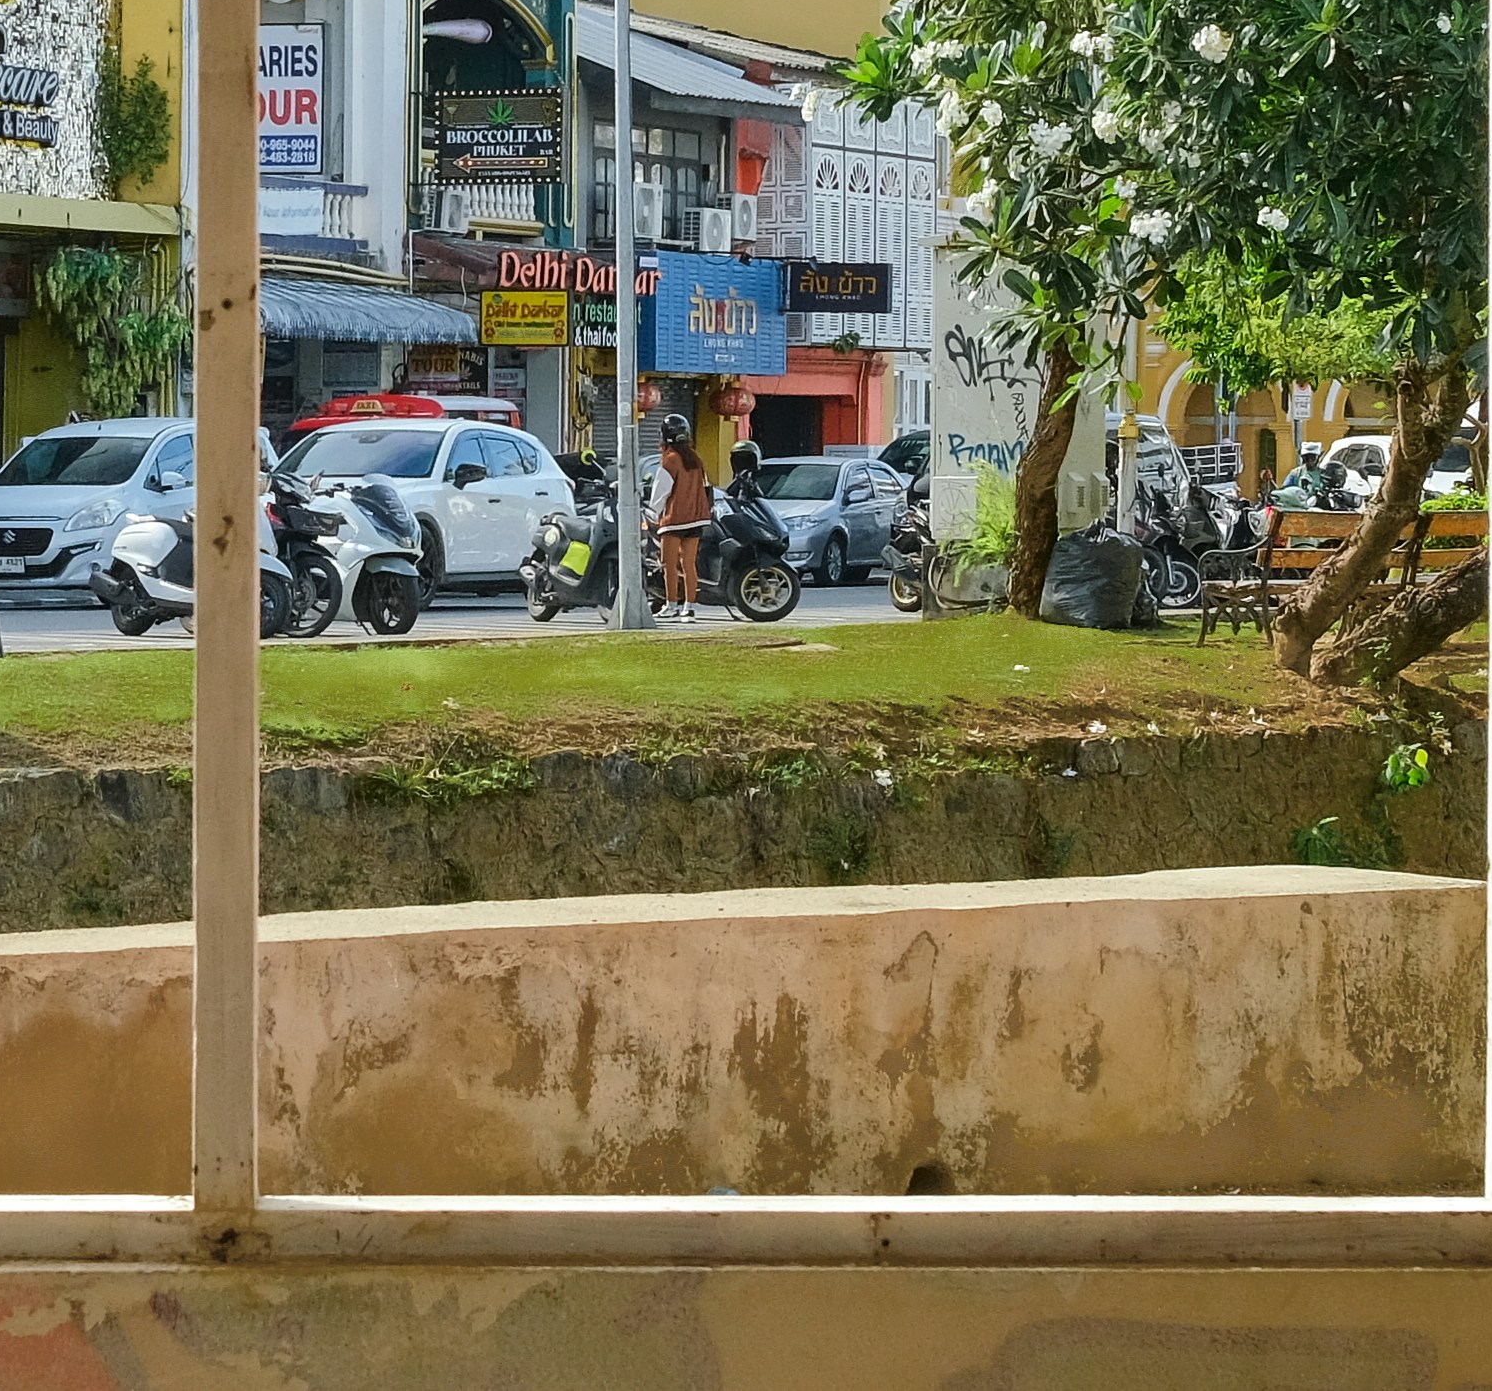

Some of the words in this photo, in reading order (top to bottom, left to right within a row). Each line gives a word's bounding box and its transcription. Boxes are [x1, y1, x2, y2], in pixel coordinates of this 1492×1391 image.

[2, 111, 14, 136] &
[16, 113, 60, 146] Beauty
[446, 129, 554, 144] BROCCOLILAB
[473, 144, 527, 157] PHUKET
[499, 250, 570, 289] Delhi
[574, 256, 663, 297] Darar
[574, 326, 584, 347] &
[602, 325, 618, 348] foo
[412, 357, 455, 373] TOUR
[459, 350, 485, 367] NABIS
[356, 401, 376, 410] TAXI
